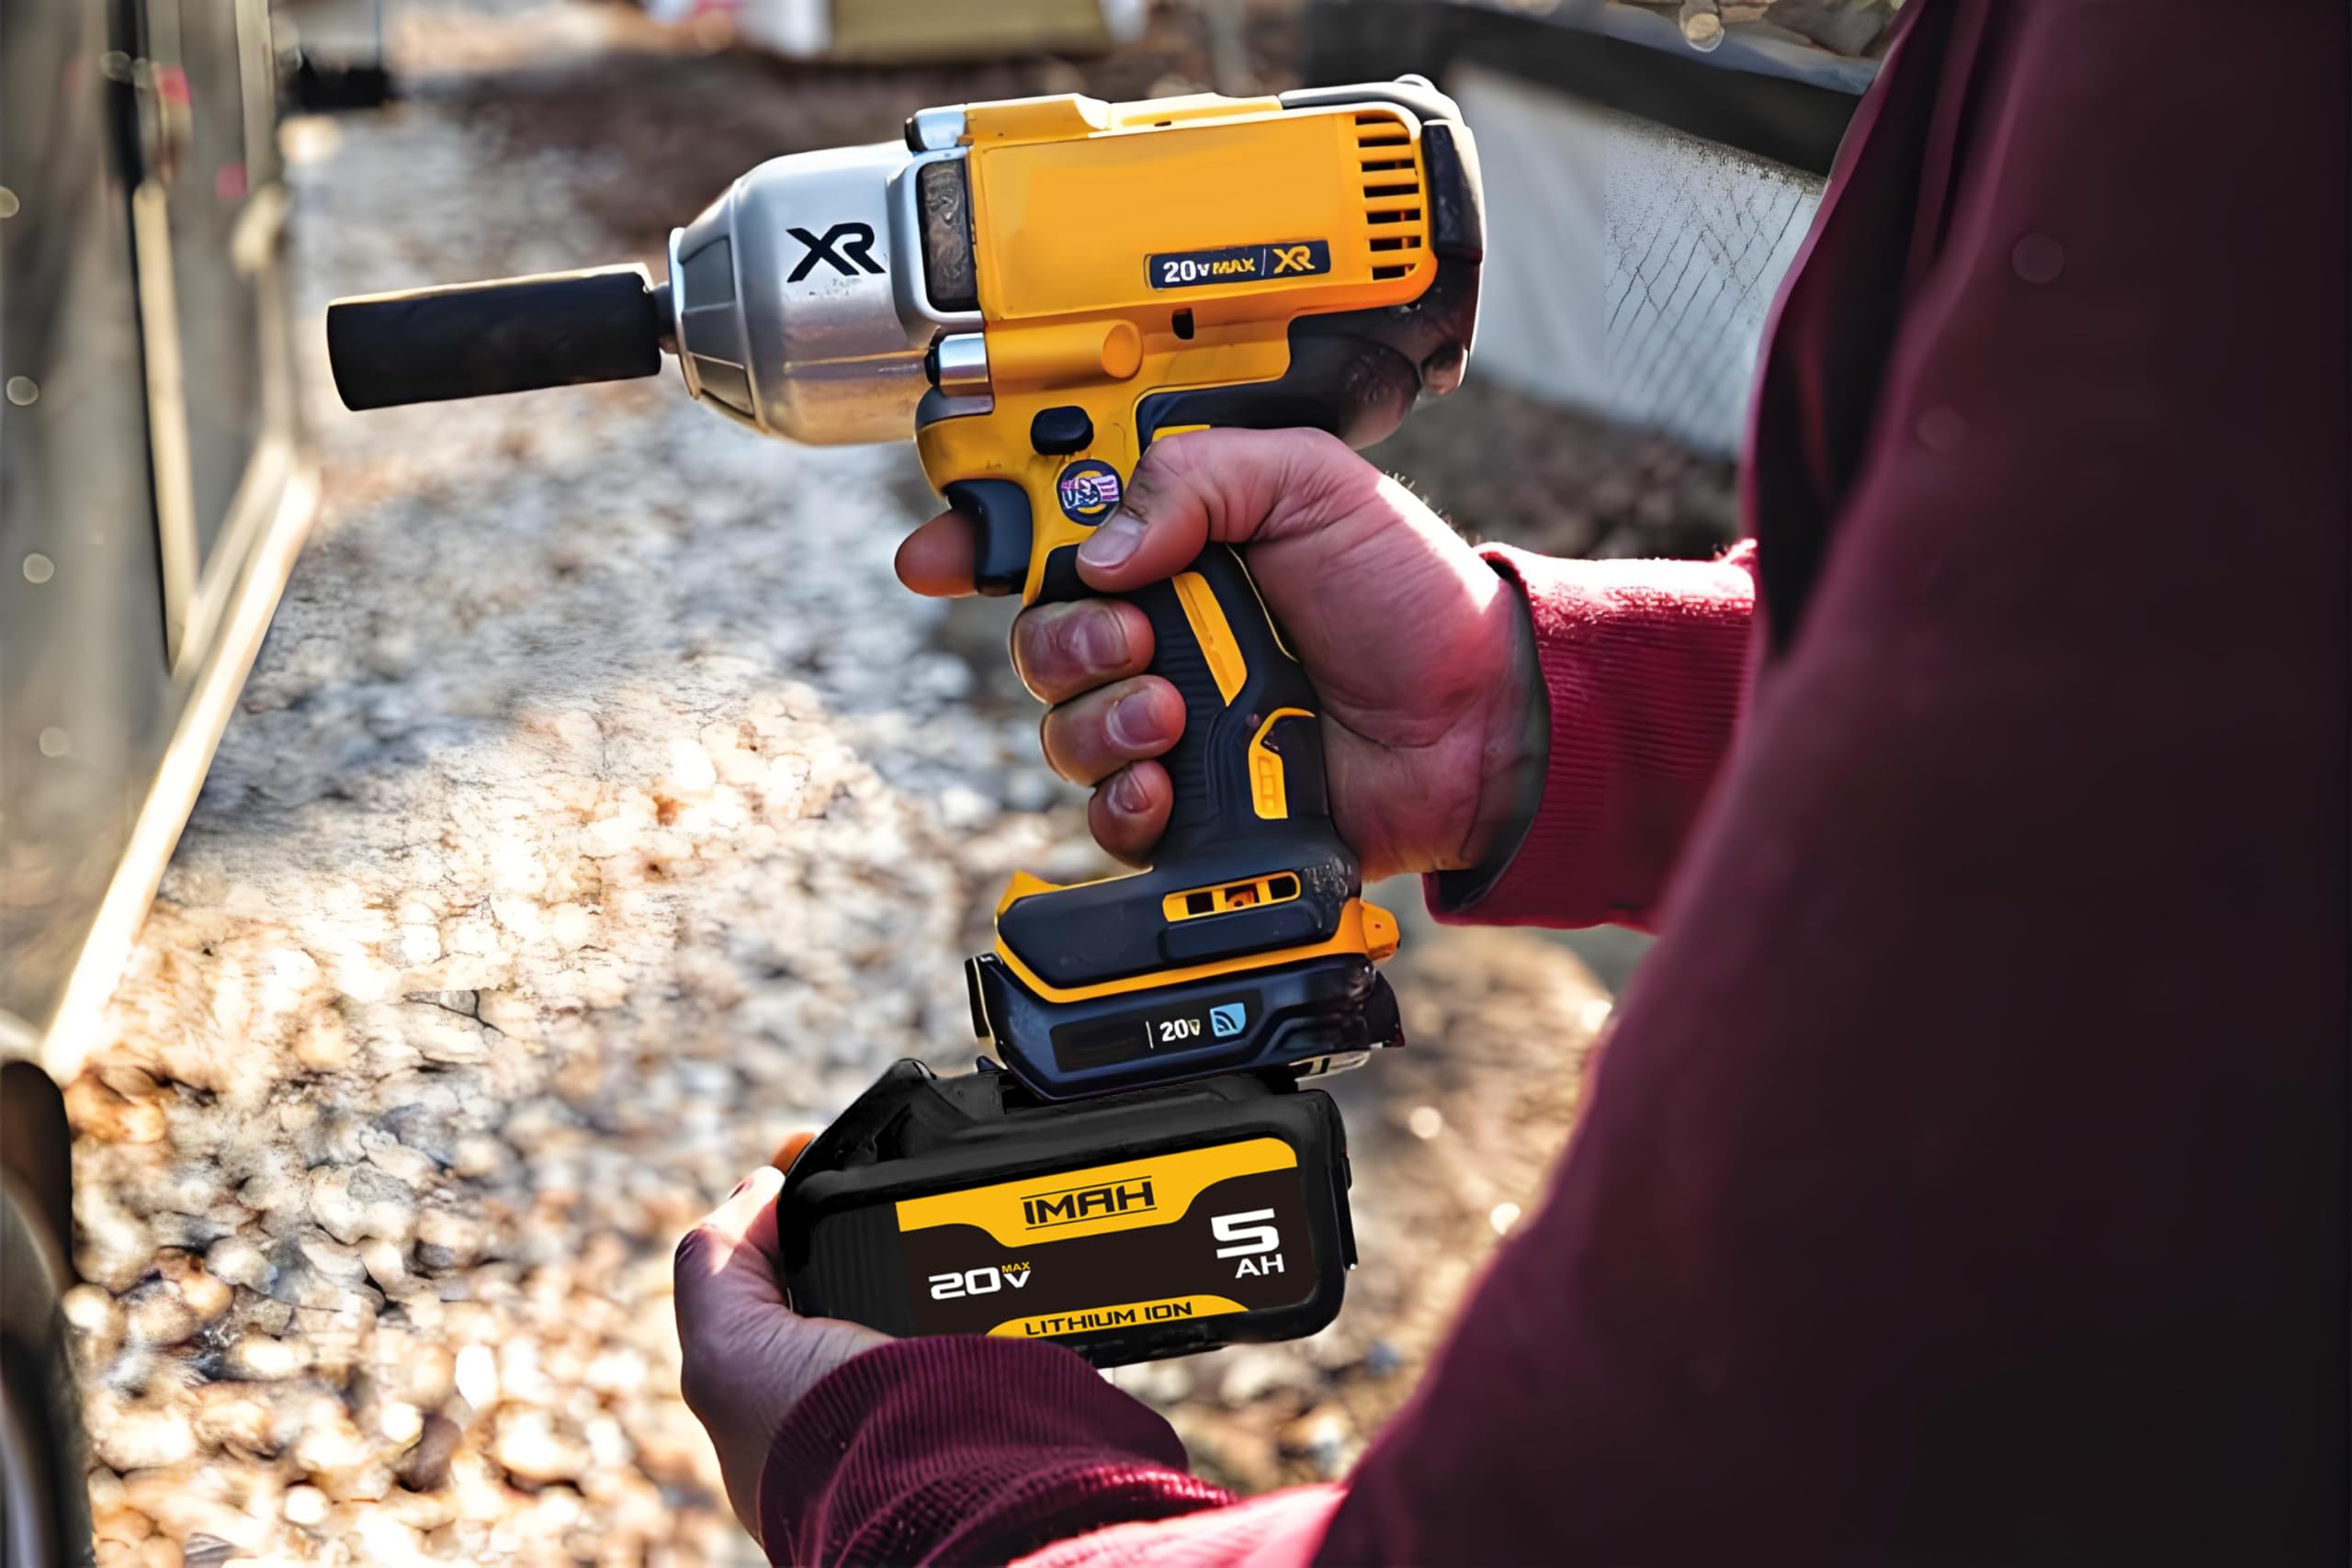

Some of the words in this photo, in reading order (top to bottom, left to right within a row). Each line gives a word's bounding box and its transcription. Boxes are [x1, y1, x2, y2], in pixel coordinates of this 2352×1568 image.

[786, 222, 887, 284] XR
[1272, 245, 1316, 274] XR
[1023, 1181, 1155, 1224] IMAH
[1210, 1207, 1280, 1258] 5
[1001, 1261, 1031, 1273] MAX
[1235, 1253, 1284, 1279] AH
[1025, 1309, 1136, 1336] LITHIUM
[1145, 1302, 1193, 1320] ION
